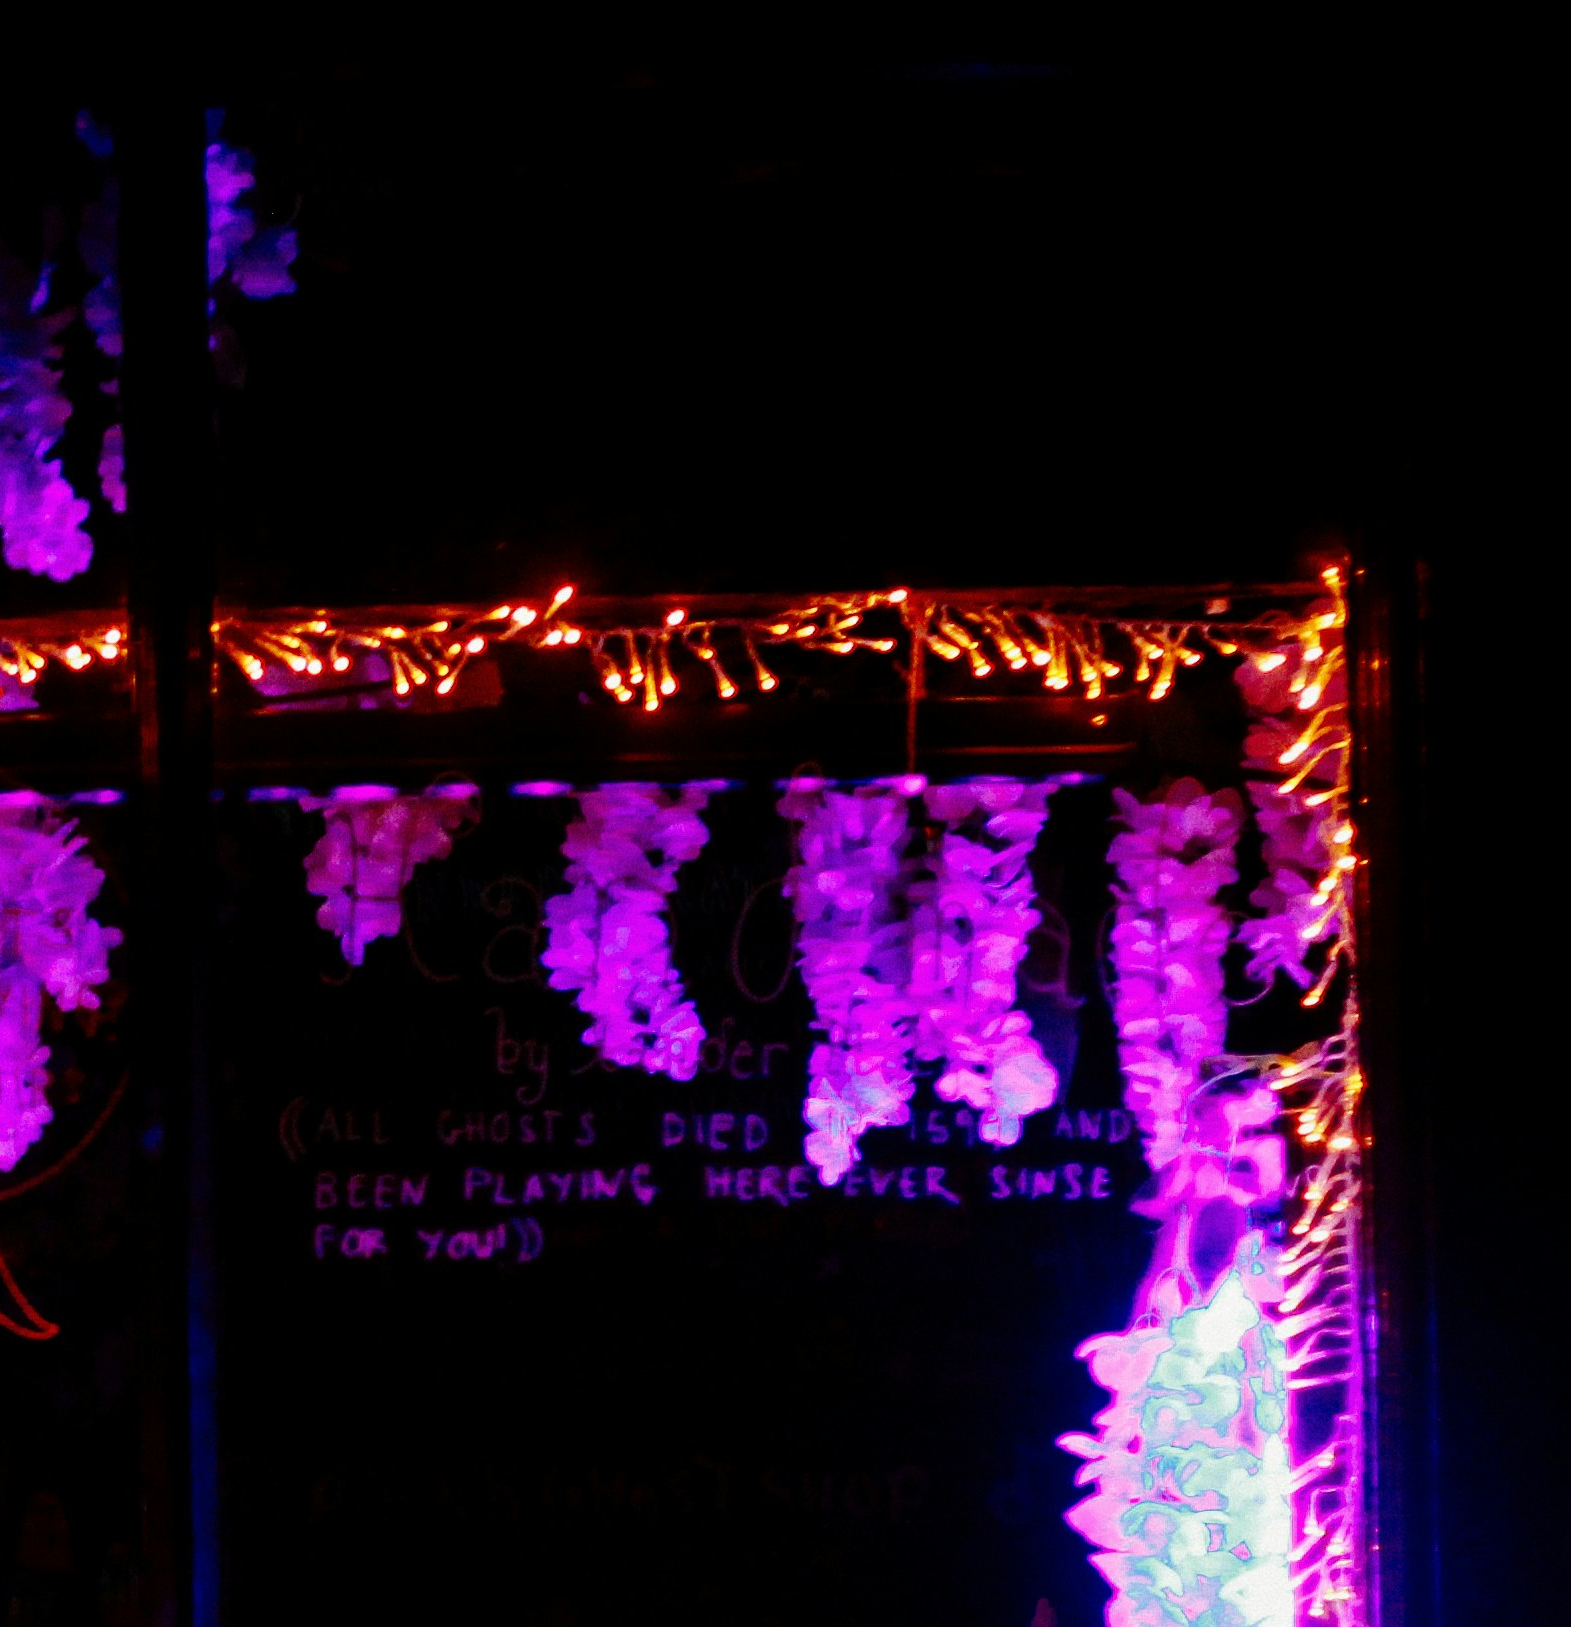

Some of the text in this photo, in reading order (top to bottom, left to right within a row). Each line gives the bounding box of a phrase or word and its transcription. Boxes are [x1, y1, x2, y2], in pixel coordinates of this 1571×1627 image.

[435, 1106, 598, 1149] GHOSTS
[659, 1110, 770, 1151] DIED
[1054, 1106, 1136, 1146] AND
[314, 1161, 1113, 1211] BEEN PLAYING HERE EVER SINSE
[312, 1221, 391, 1262] FOR
